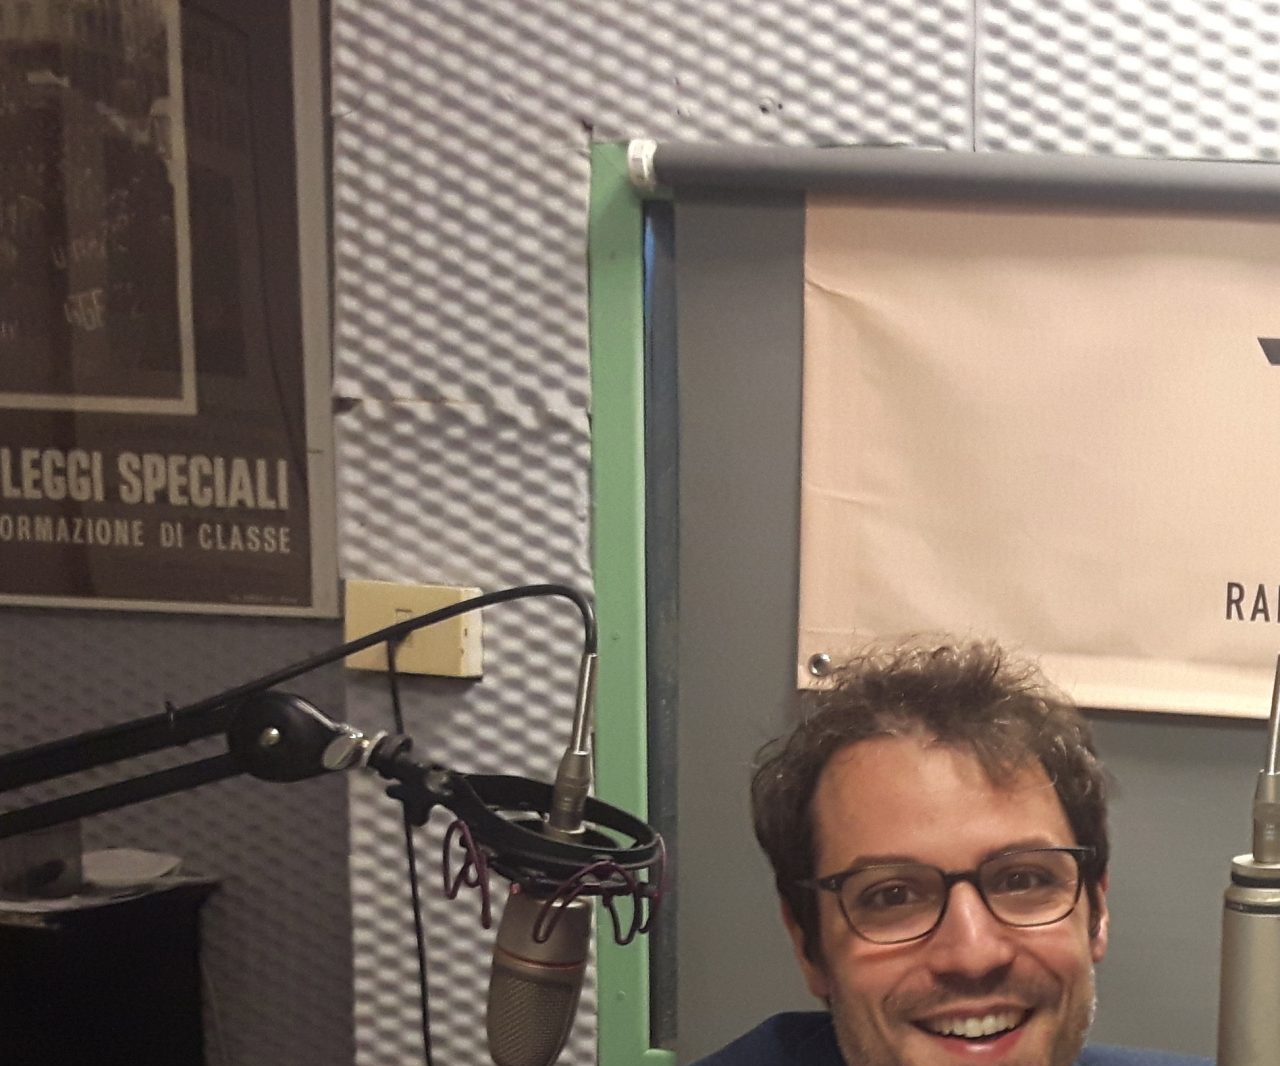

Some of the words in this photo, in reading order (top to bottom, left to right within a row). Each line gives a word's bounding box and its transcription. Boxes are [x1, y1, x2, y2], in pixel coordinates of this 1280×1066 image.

[2, 448, 104, 501] LEGGI
[117, 453, 289, 509] SPECIALI
[0, 514, 144, 547] ORMAZIONE
[159, 521, 183, 548] DI
[199, 523, 291, 553] CLASSE
